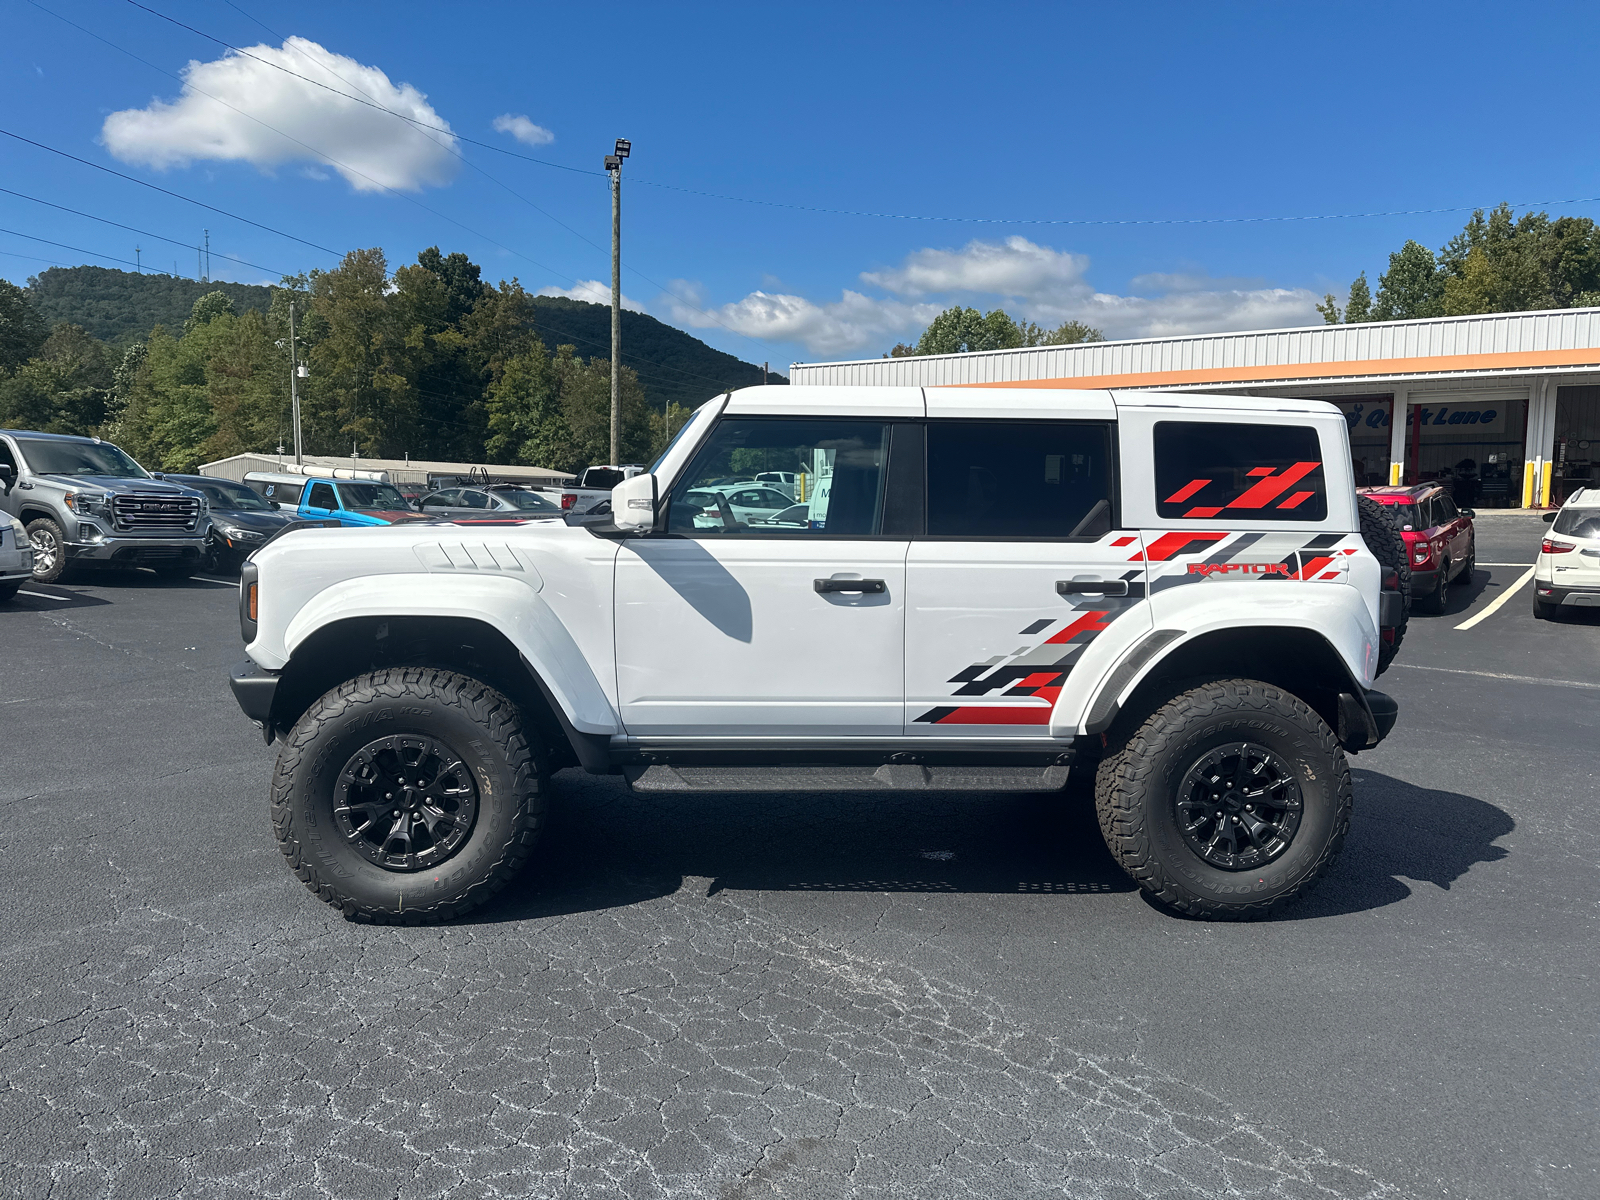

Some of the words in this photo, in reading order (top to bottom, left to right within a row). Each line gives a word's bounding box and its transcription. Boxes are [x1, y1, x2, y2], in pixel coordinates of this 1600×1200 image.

[1365, 408, 1433, 428] Quck
[1433, 407, 1498, 425] Lane
[143, 503, 178, 512] GMC
[1187, 563, 1293, 579] RAPTOR
[344, 707, 395, 734] T/A
[399, 706, 432, 717] KO2
